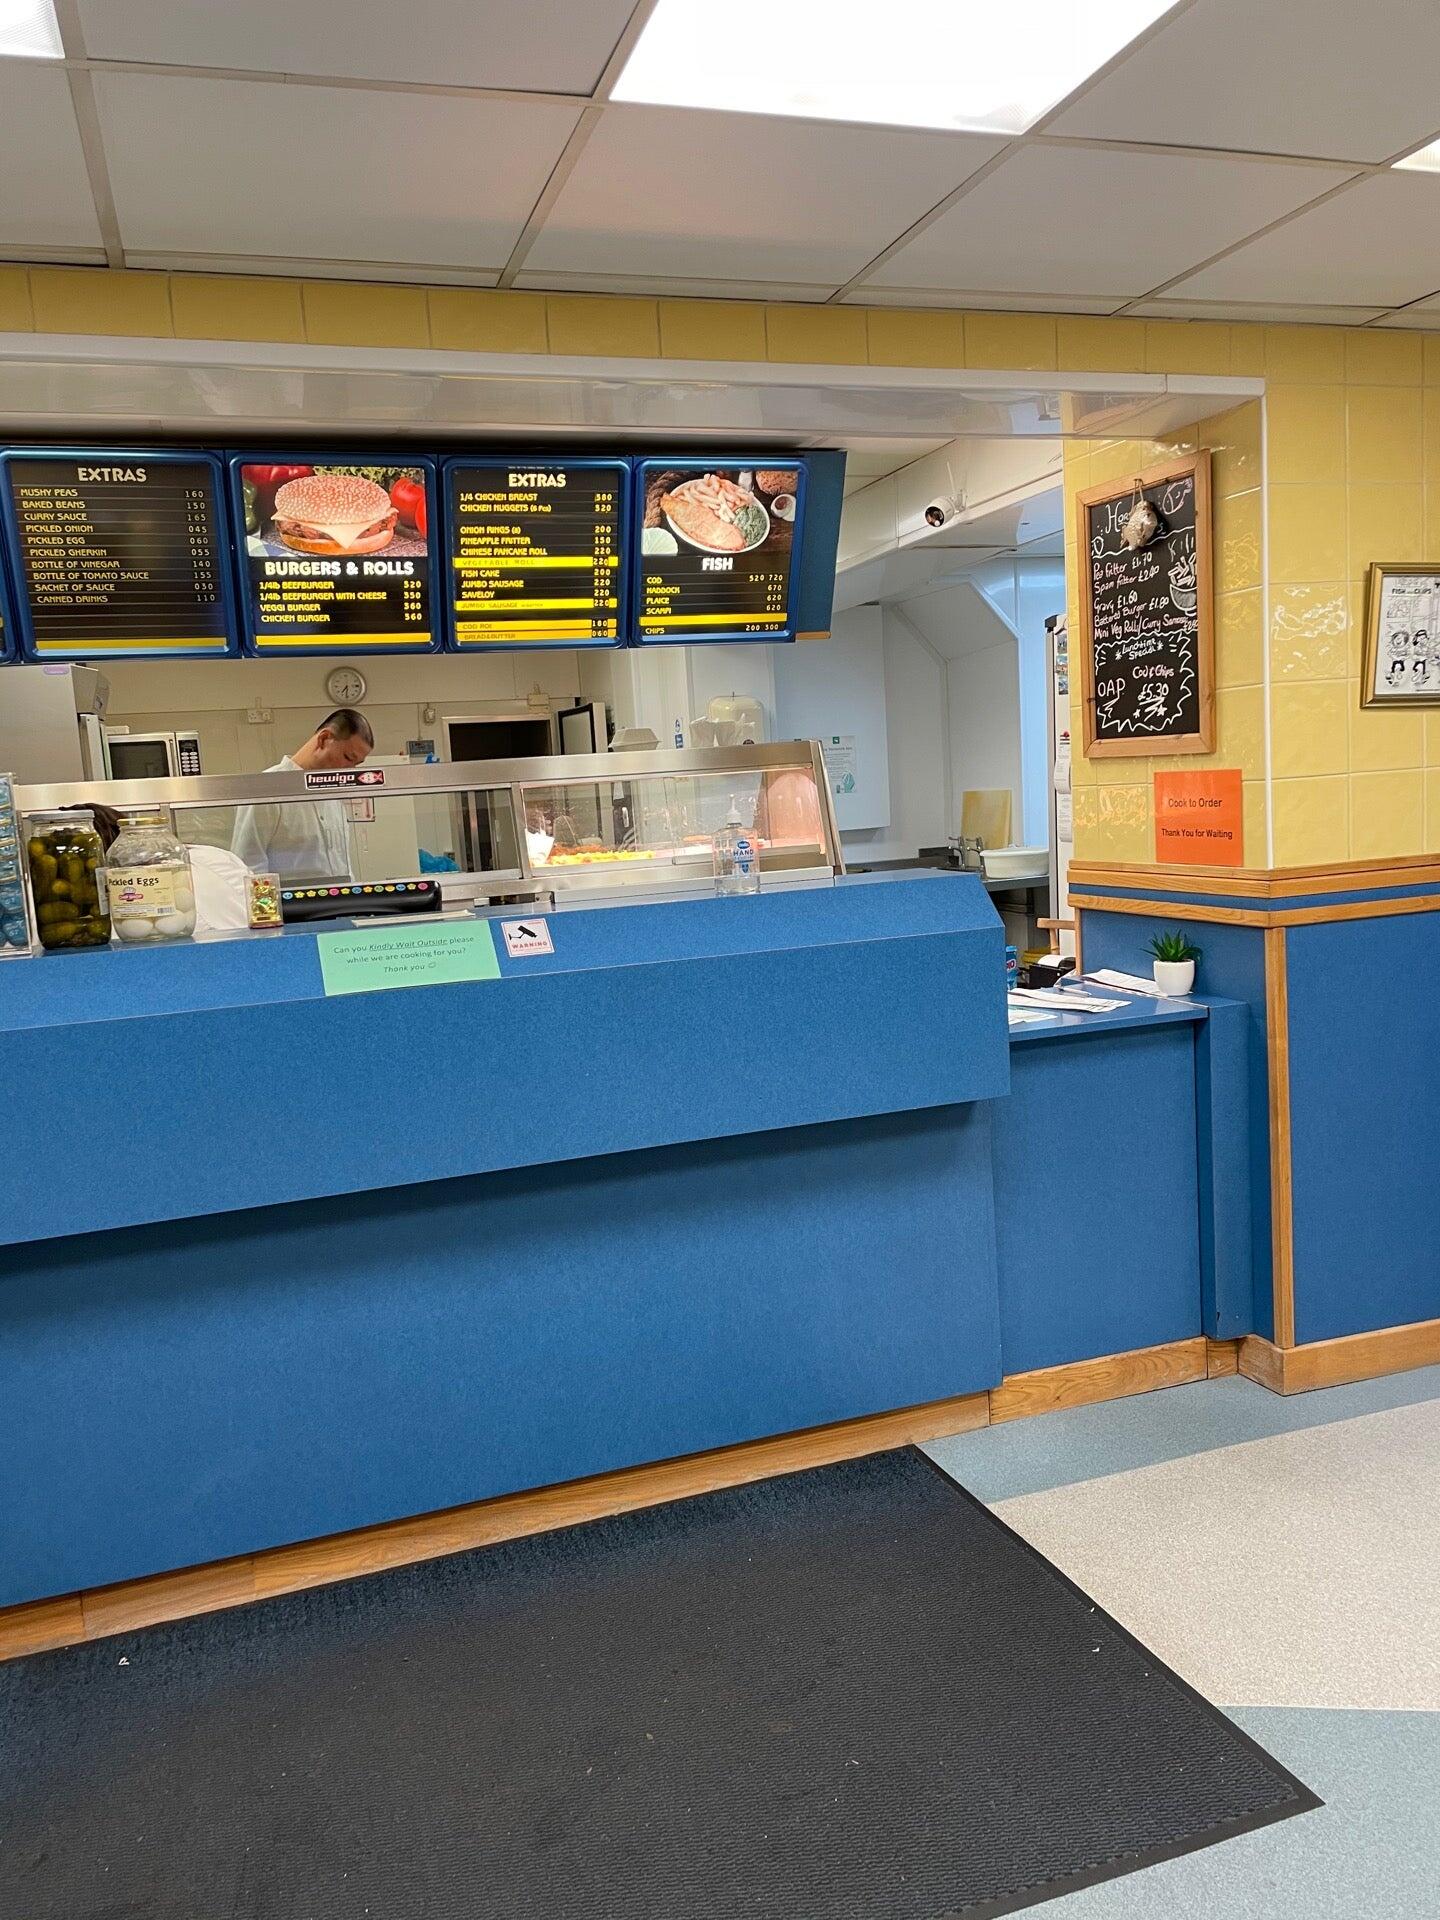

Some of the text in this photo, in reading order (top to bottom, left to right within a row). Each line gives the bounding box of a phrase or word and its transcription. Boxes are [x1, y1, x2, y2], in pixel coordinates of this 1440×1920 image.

[77, 467, 147, 482] EXTRAS
[508, 473, 567, 488] EXTRAS
[20, 488, 52, 497] MUSHY
[54, 488, 78, 497] PEAS
[460, 493, 473, 501] 1/4
[474, 493, 507, 501] CHICKEN
[508, 493, 538, 501] BREAST
[22, 500, 53, 509] BAKED
[55, 500, 86, 509] BEANS
[460, 504, 492, 512] CHICKEN
[493, 504, 529, 512] NUGGETS
[24, 513, 55, 521] CURRY
[57, 513, 87, 521] SAUCE
[25, 524, 62, 533] PICKLED
[64, 524, 94, 533] ONION
[460, 526, 485, 534] ONION
[486, 526, 511, 534] RINGS
[594, 525, 612, 533] 200
[27, 536, 64, 545] PICKLED
[66, 536, 86, 545] EGG
[460, 536, 611, 545] PINEAPPLE FRITTER 150
[460, 547, 611, 556] CHINESE PANCAKE ROLL 220
[80, 560, 120, 568] VINEGAR
[264, 561, 415, 576] BURGERS & ROLLS
[702, 557, 734, 571] FISH
[82, 572, 118, 580] TOMATO
[120, 571, 149, 579] SAUCE
[461, 568, 611, 578] FISH CAKE 200
[461, 578, 610, 588] JUMBO SAUSAGE 220
[646, 576, 663, 584] COD
[86, 583, 115, 591] SAUCE
[281, 581, 334, 590] BEEFBURGER
[646, 586, 681, 594] HADDOCK
[1094, 581, 1114, 596] Spam
[37, 595, 73, 603] CANNED
[75, 595, 108, 603] DRINKS
[282, 592, 335, 601] BEEFBURGER
[335, 592, 356, 600] WITH
[357, 591, 387, 600] CHEESE
[461, 590, 496, 599] SAVELOY
[646, 597, 670, 605] PLAICE
[1094, 597, 1115, 614] Gravy
[259, 604, 286, 612] VEGGI
[287, 603, 321, 612] BURGER
[646, 607, 672, 615] SCAMPI
[1122, 602, 1148, 619] Burger
[261, 615, 296, 623] CHICKEN
[297, 614, 331, 623] BURGER
[645, 627, 665, 635] CHIPS
[745, 624, 760, 632] 200
[1094, 627, 1109, 640] Mini
[1110, 621, 1123, 640] Veg
[1132, 665, 1149, 679] Cod
[1155, 664, 1175, 678] Chips
[1137, 682, 1170, 701] £5.30
[308, 773, 355, 784] hewigo
[1168, 797, 1223, 808] Cook to Order
[1161, 828, 1233, 841] Thank You for Waiting
[137, 877, 160, 887] Eggs
[333, 936, 475, 954] Can you Kindly Wait Outside please
[512, 941, 548, 949] WARNING
[346, 956, 369, 964] while
[400, 951, 432, 960] cooking
[433, 949, 445, 957] for
[447, 947, 467, 957] you?
[384, 964, 426, 973] Thank you
